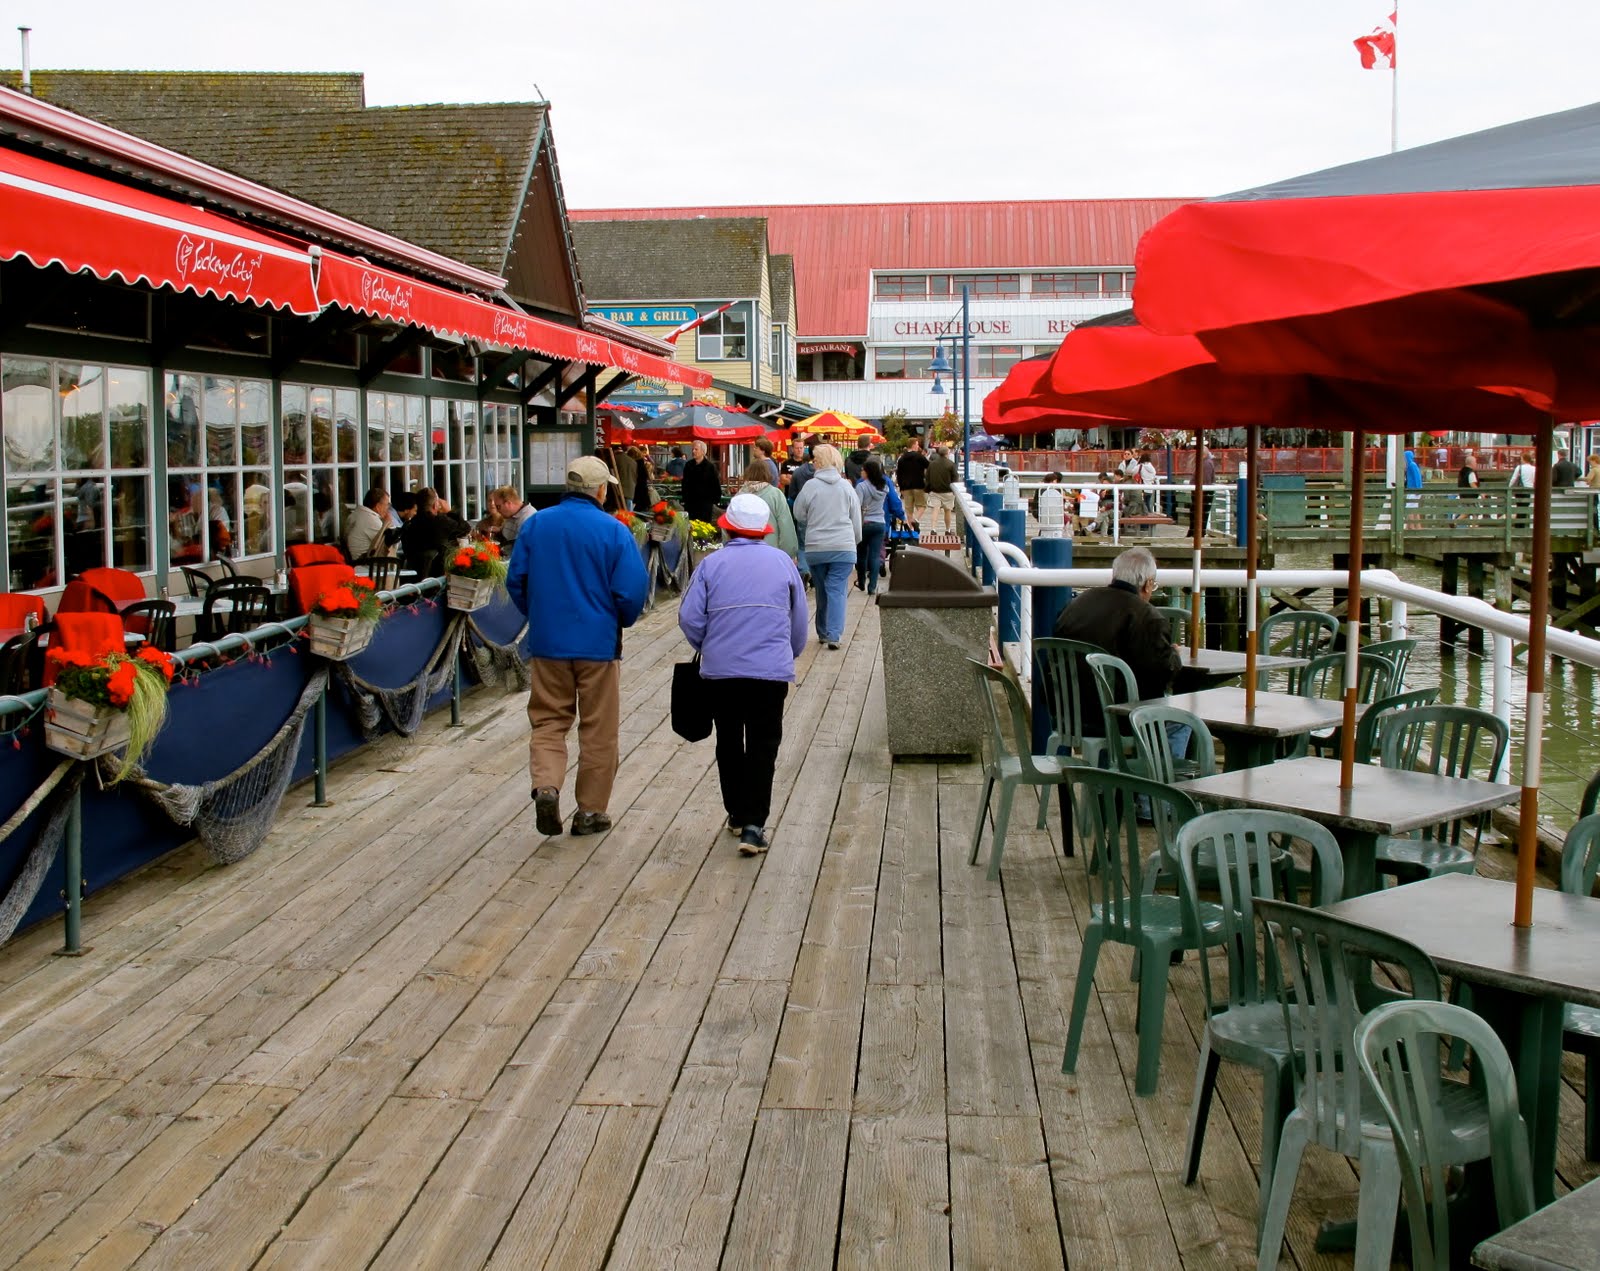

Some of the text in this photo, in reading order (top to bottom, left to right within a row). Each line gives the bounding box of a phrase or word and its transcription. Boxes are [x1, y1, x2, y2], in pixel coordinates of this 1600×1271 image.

[610, 312, 634, 322] BAR
[640, 311, 648, 322] &
[653, 311, 689, 321] GRILL
[800, 344, 851, 353] RESTAURANT
